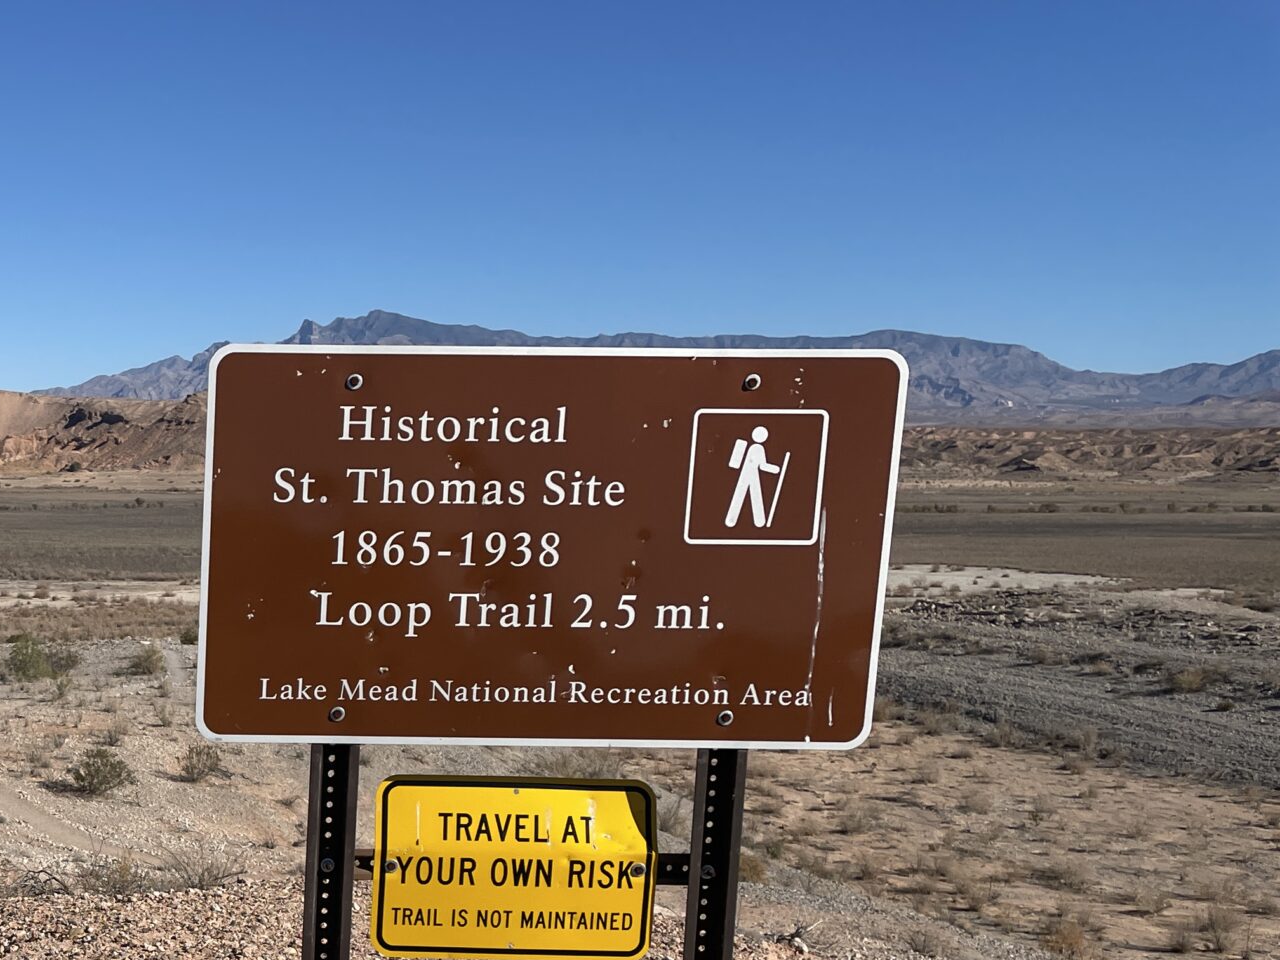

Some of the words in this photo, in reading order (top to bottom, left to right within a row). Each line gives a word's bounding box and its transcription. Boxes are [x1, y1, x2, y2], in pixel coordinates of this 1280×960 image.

[338, 405, 567, 444] Historical
[273, 467, 327, 504] St.
[346, 468, 525, 506] Thomas
[543, 470, 625, 507] Site
[330, 530, 561, 567] 1865-1938
[315, 592, 432, 636] Loop
[449, 592, 552, 628] Trail
[571, 595, 637, 629] 2.5
[654, 596, 725, 631] mi.
[259, 678, 327, 701] Lake
[338, 679, 418, 702] Mead
[429, 680, 556, 704] National
[568, 681, 729, 706] Recreation
[740, 684, 809, 707] Area
[438, 813, 549, 843] TRAVEL
[562, 816, 592, 844] AT
[396, 856, 477, 886] YOUR
[491, 858, 553, 888] OWN
[568, 860, 634, 889] RISK
[392, 907, 443, 926] TRAIL
[451, 909, 468, 927] IS
[477, 909, 512, 928] NOT
[521, 911, 633, 931] MAINTAINED
